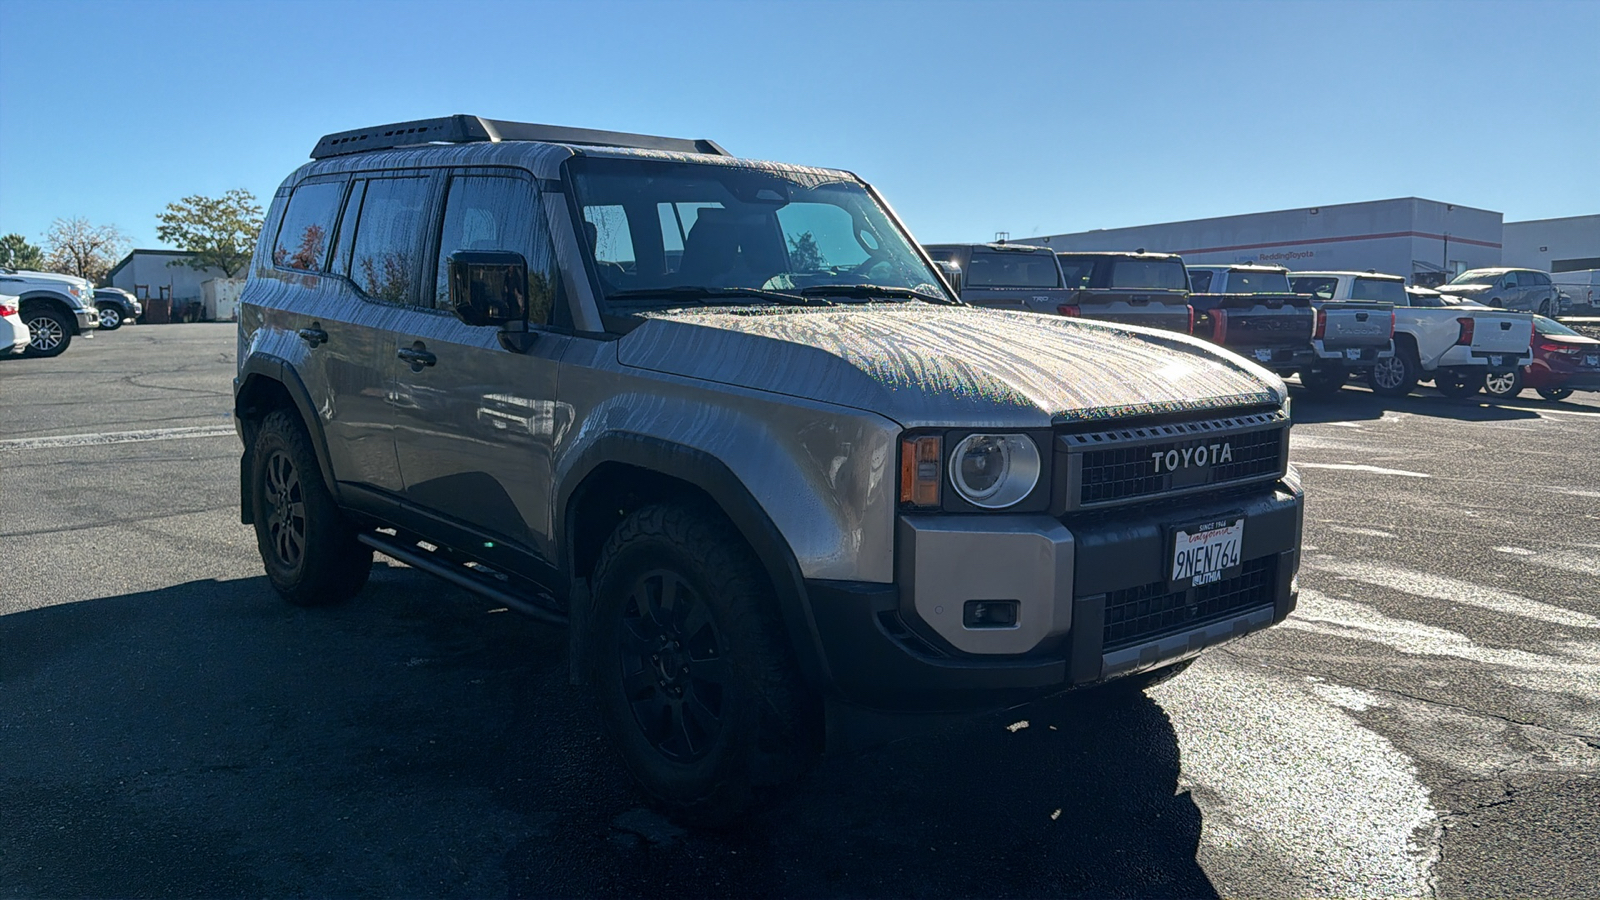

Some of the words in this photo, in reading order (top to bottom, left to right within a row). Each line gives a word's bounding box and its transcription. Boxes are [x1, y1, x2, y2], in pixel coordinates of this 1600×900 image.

[1260, 250, 1314, 261] ReddingToyota
[1151, 442, 1233, 473] TOYOTA
[1188, 527, 1232, 545] California
[1198, 522, 1215, 532] SINCE
[1175, 539, 1239, 580] 9NEN764
